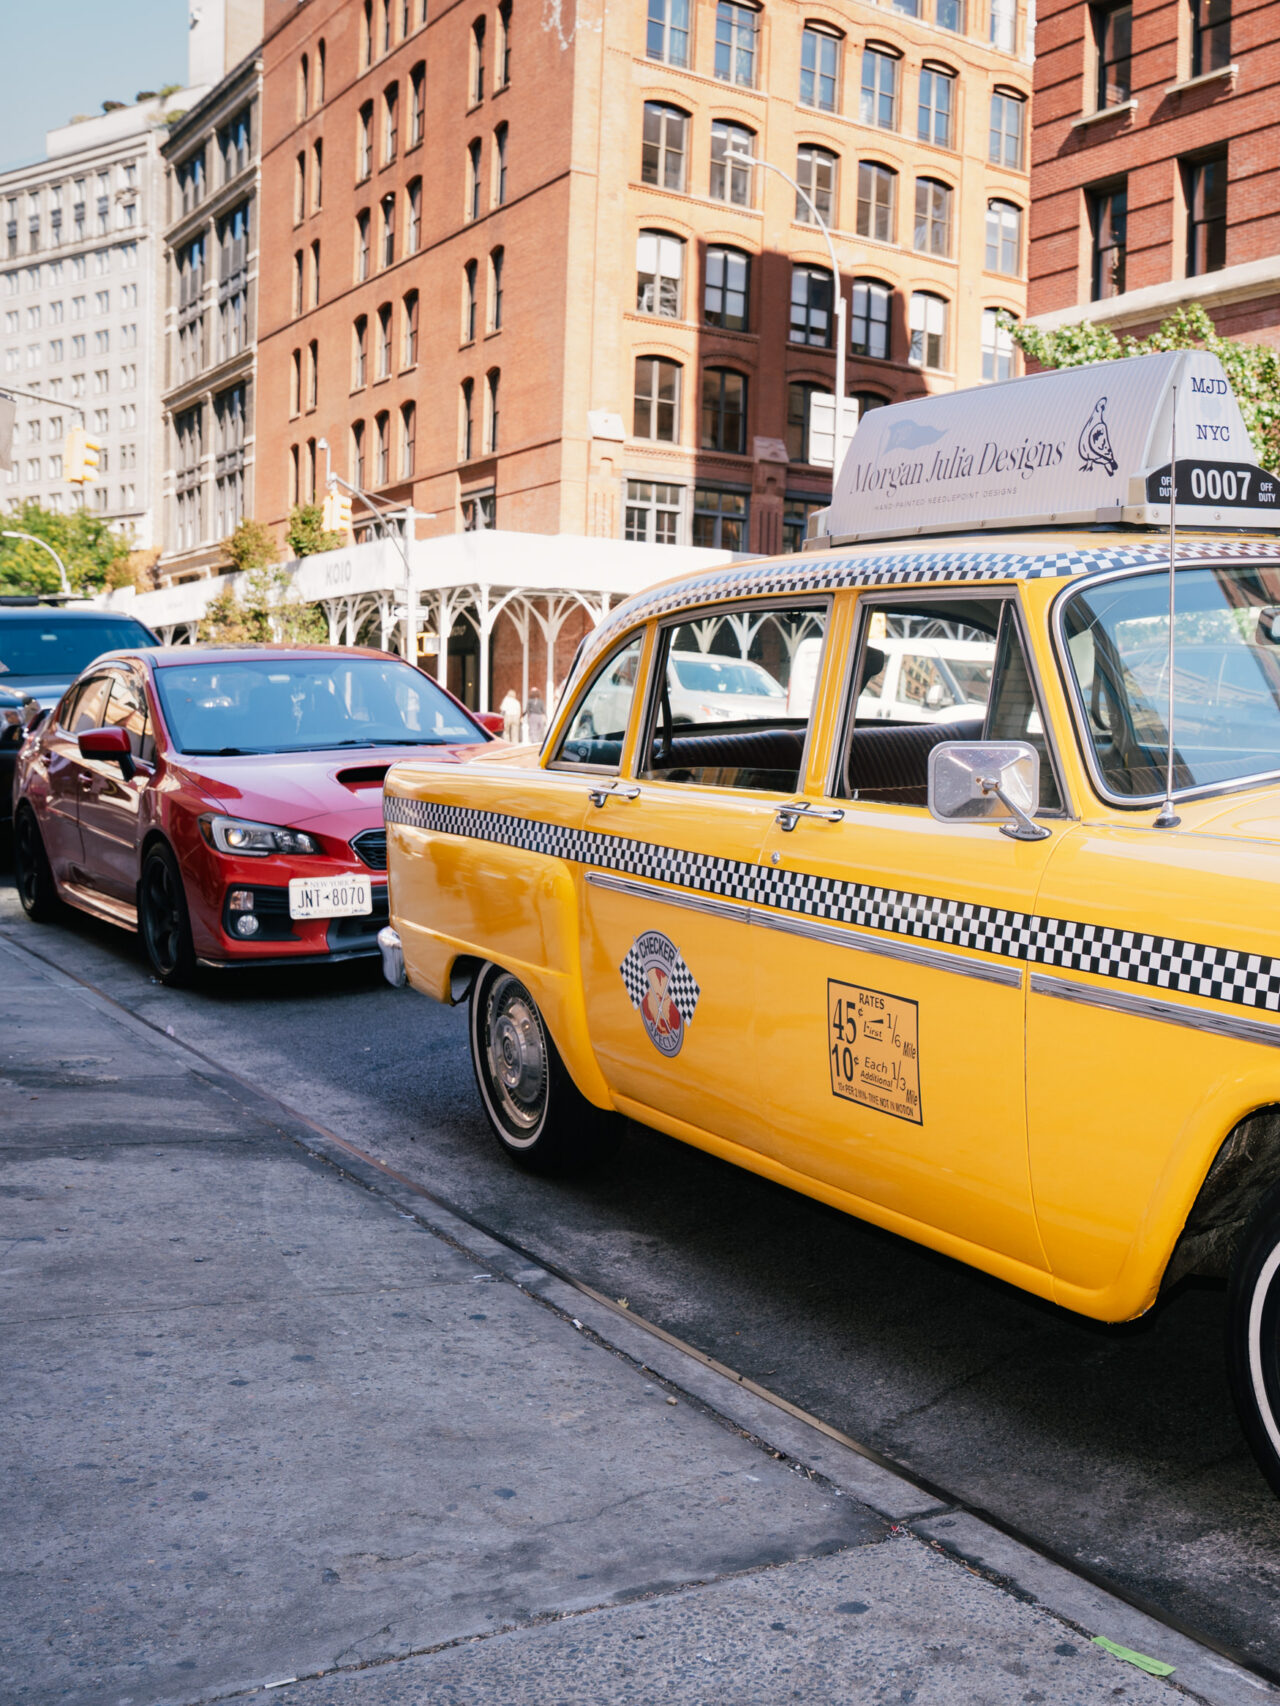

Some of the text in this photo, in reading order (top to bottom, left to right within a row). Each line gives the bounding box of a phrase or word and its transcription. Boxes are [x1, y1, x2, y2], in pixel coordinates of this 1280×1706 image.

[1191, 377, 1228, 395] MJD
[1196, 424, 1230, 441] NYC
[849, 438, 1066, 498] Morgan Julia Designs
[1190, 468, 1252, 501] 0007
[1260, 482, 1273, 491] OFF
[928, 490, 979, 504] NEEDLEPOINT
[983, 486, 1018, 499] DESIGNS
[1259, 492, 1276, 503] DUTY
[332, 886, 364, 906] 8070
[638, 936, 676, 966] CHECKER
[859, 992, 885, 1010] RATES
[649, 1021, 679, 1049] SPECIAL
[902, 1041, 916, 1060] Mile
[864, 1056, 888, 1074] Each
[860, 1070, 893, 1088] Additional
[906, 1089, 918, 1106] Mile
